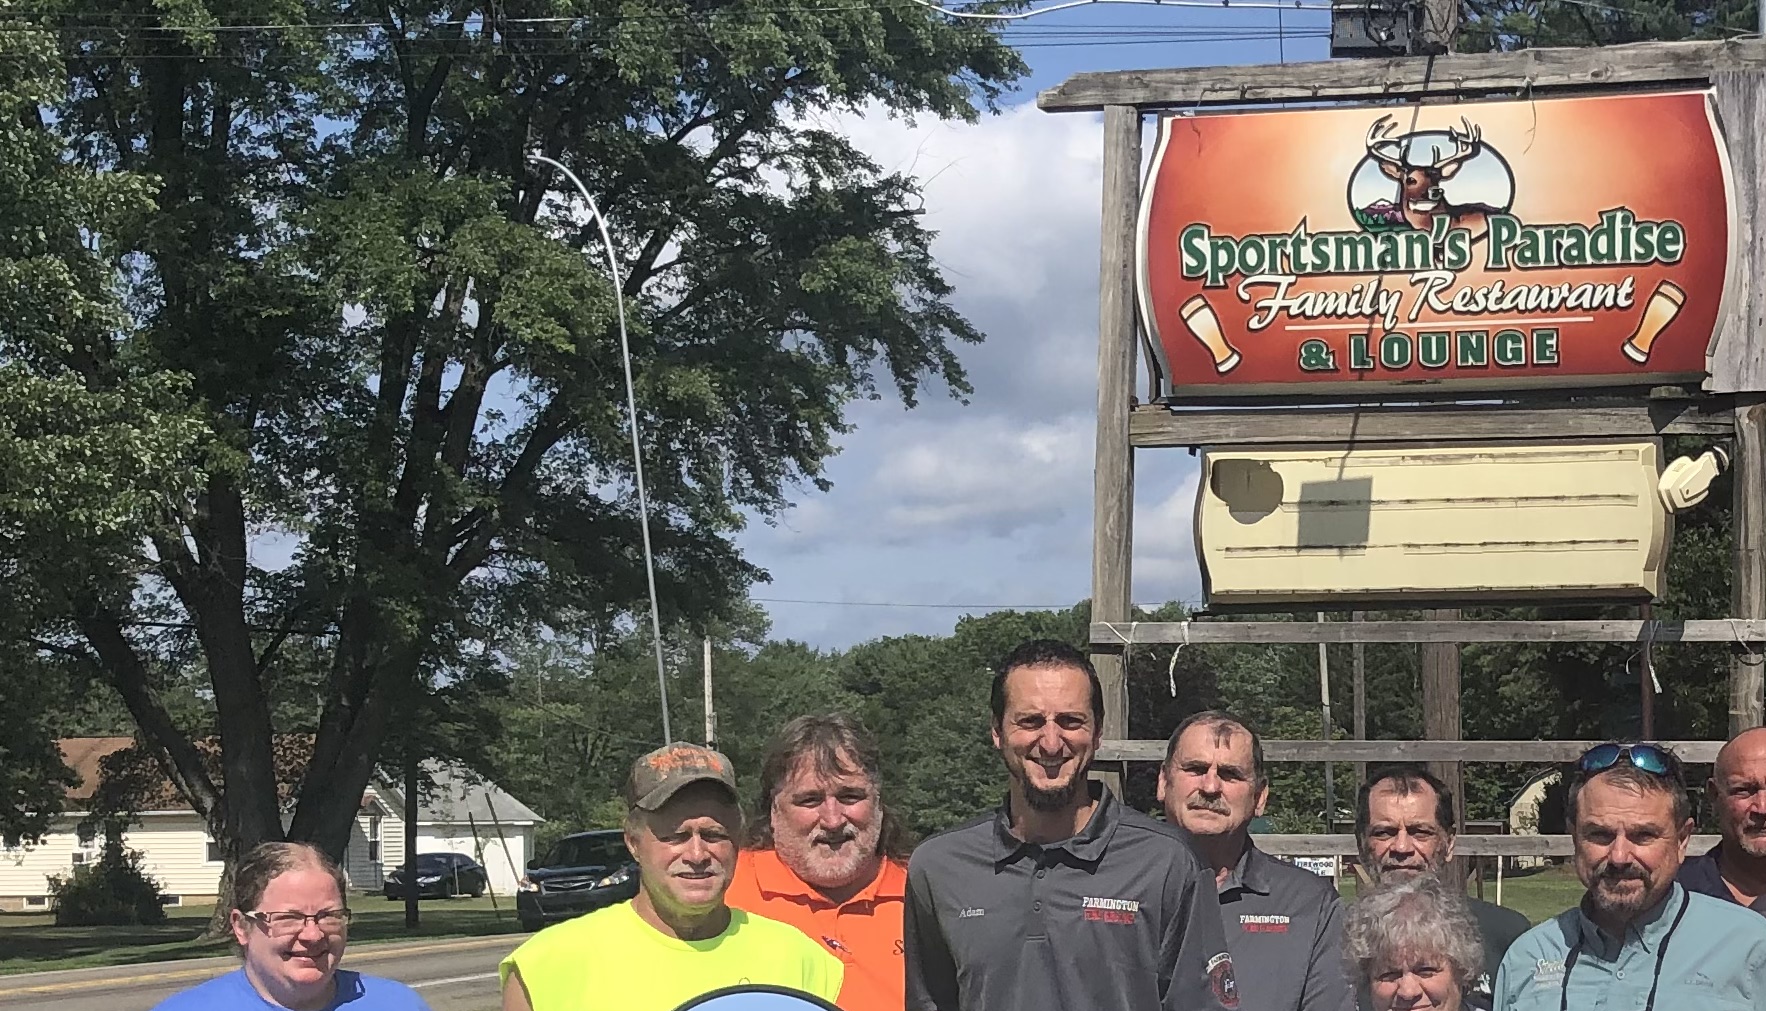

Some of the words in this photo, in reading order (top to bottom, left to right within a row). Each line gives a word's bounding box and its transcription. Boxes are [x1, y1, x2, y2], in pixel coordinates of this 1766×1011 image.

[1181, 214, 1471, 287] Sportsman's
[1487, 207, 1685, 270] Paradise
[1238, 275, 1401, 331] Family
[1409, 270, 1635, 321] Restaurant
[1300, 340, 1338, 371] &
[1350, 328, 1559, 369] LOUNGE
[1082, 896, 1140, 912] FARMINGTON
